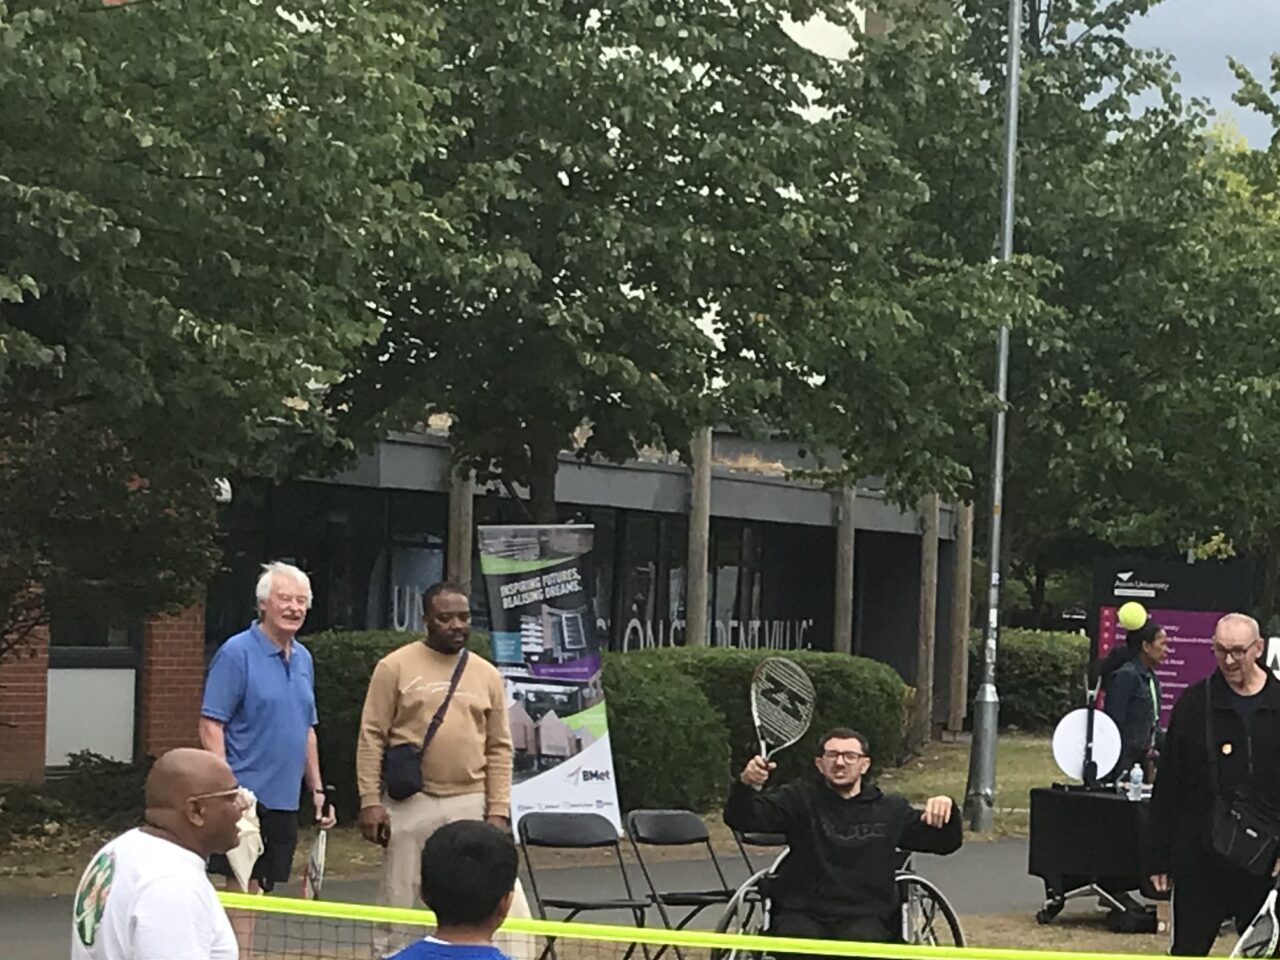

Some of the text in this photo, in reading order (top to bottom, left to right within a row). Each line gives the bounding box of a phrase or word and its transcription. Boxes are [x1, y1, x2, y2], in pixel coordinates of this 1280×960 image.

[500, 577, 542, 597] INSPIRING
[502, 580, 582, 610] REALISING DREAMS.
[582, 769, 611, 782] BMet
